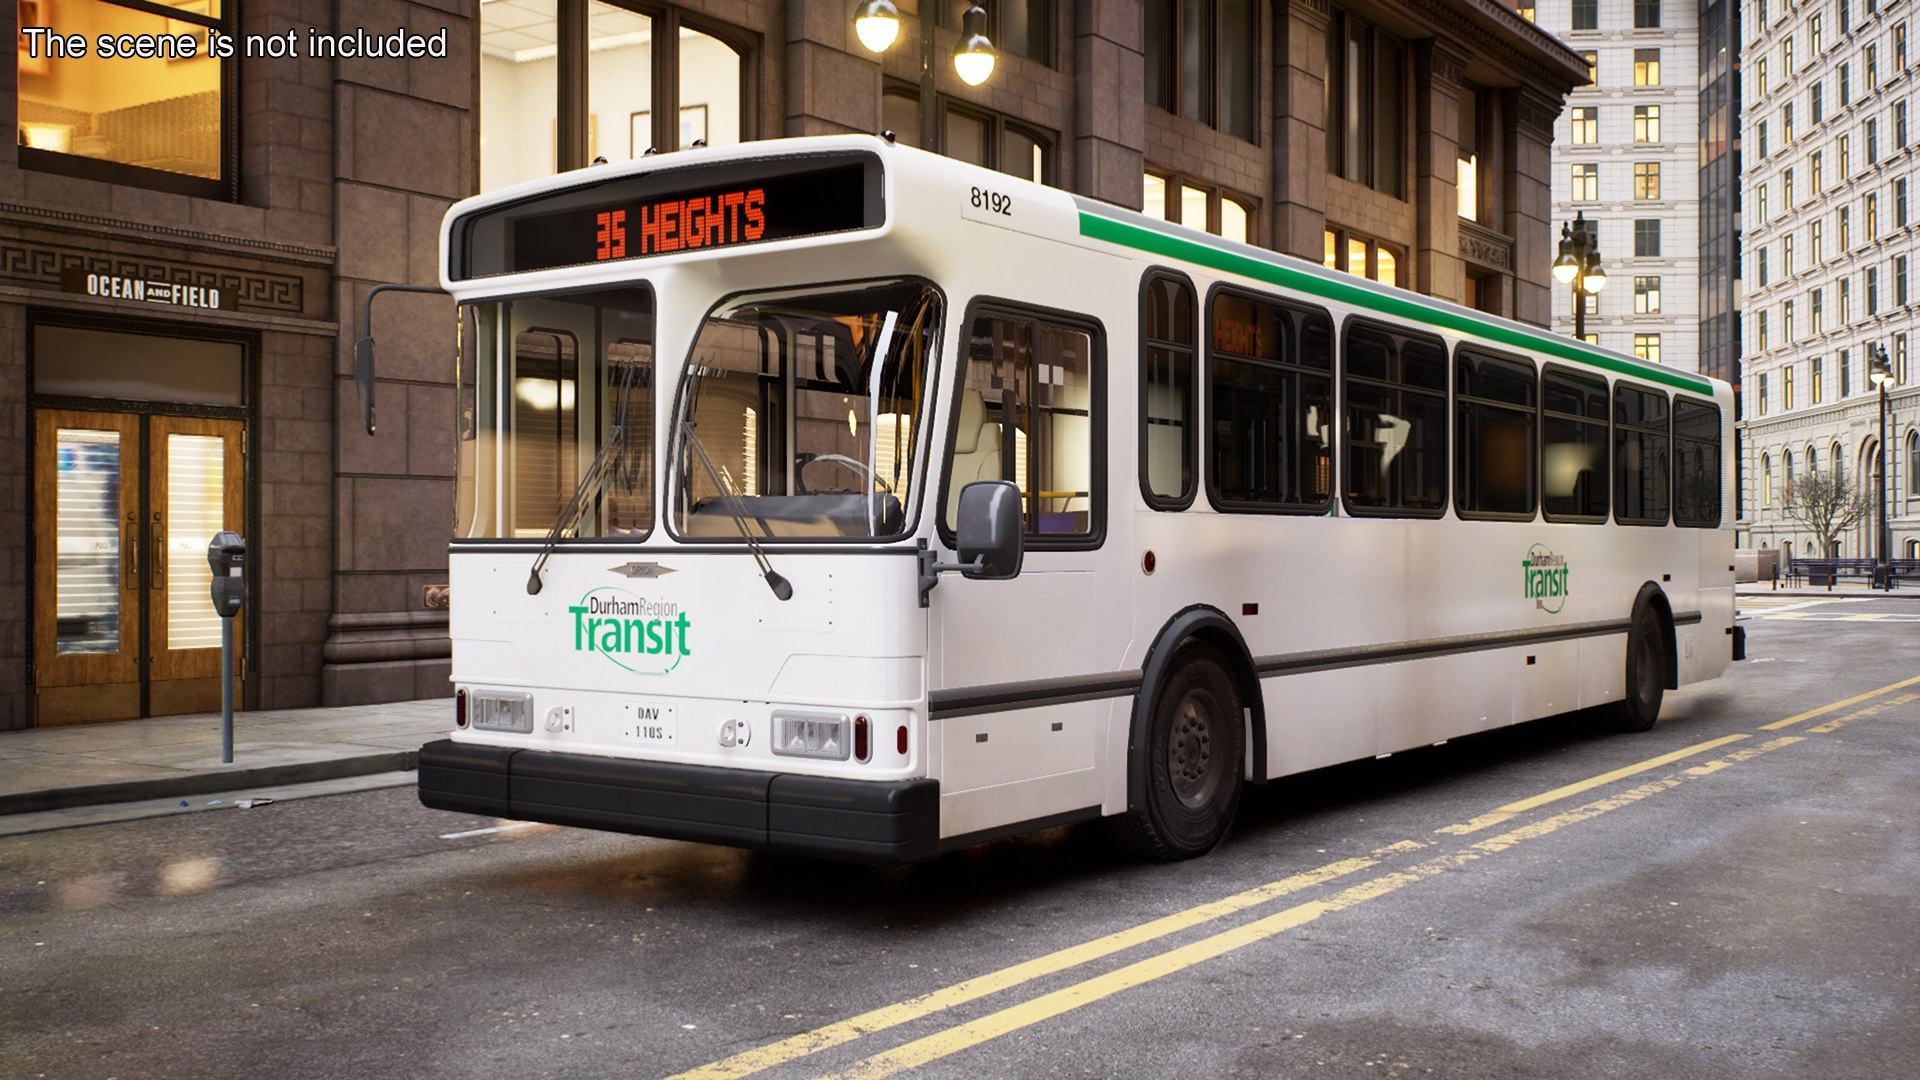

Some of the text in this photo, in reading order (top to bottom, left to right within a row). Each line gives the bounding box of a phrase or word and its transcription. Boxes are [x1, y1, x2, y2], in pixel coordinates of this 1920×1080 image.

[971, 186, 1012, 217] 8192
[596, 189, 766, 260] 35 HEIGHTS
[87, 274, 220, 309] OCEAN AND FIELD
[1522, 560, 1568, 598] Transit
[568, 606, 691, 656] Transit
[638, 707, 660, 720] DAV
